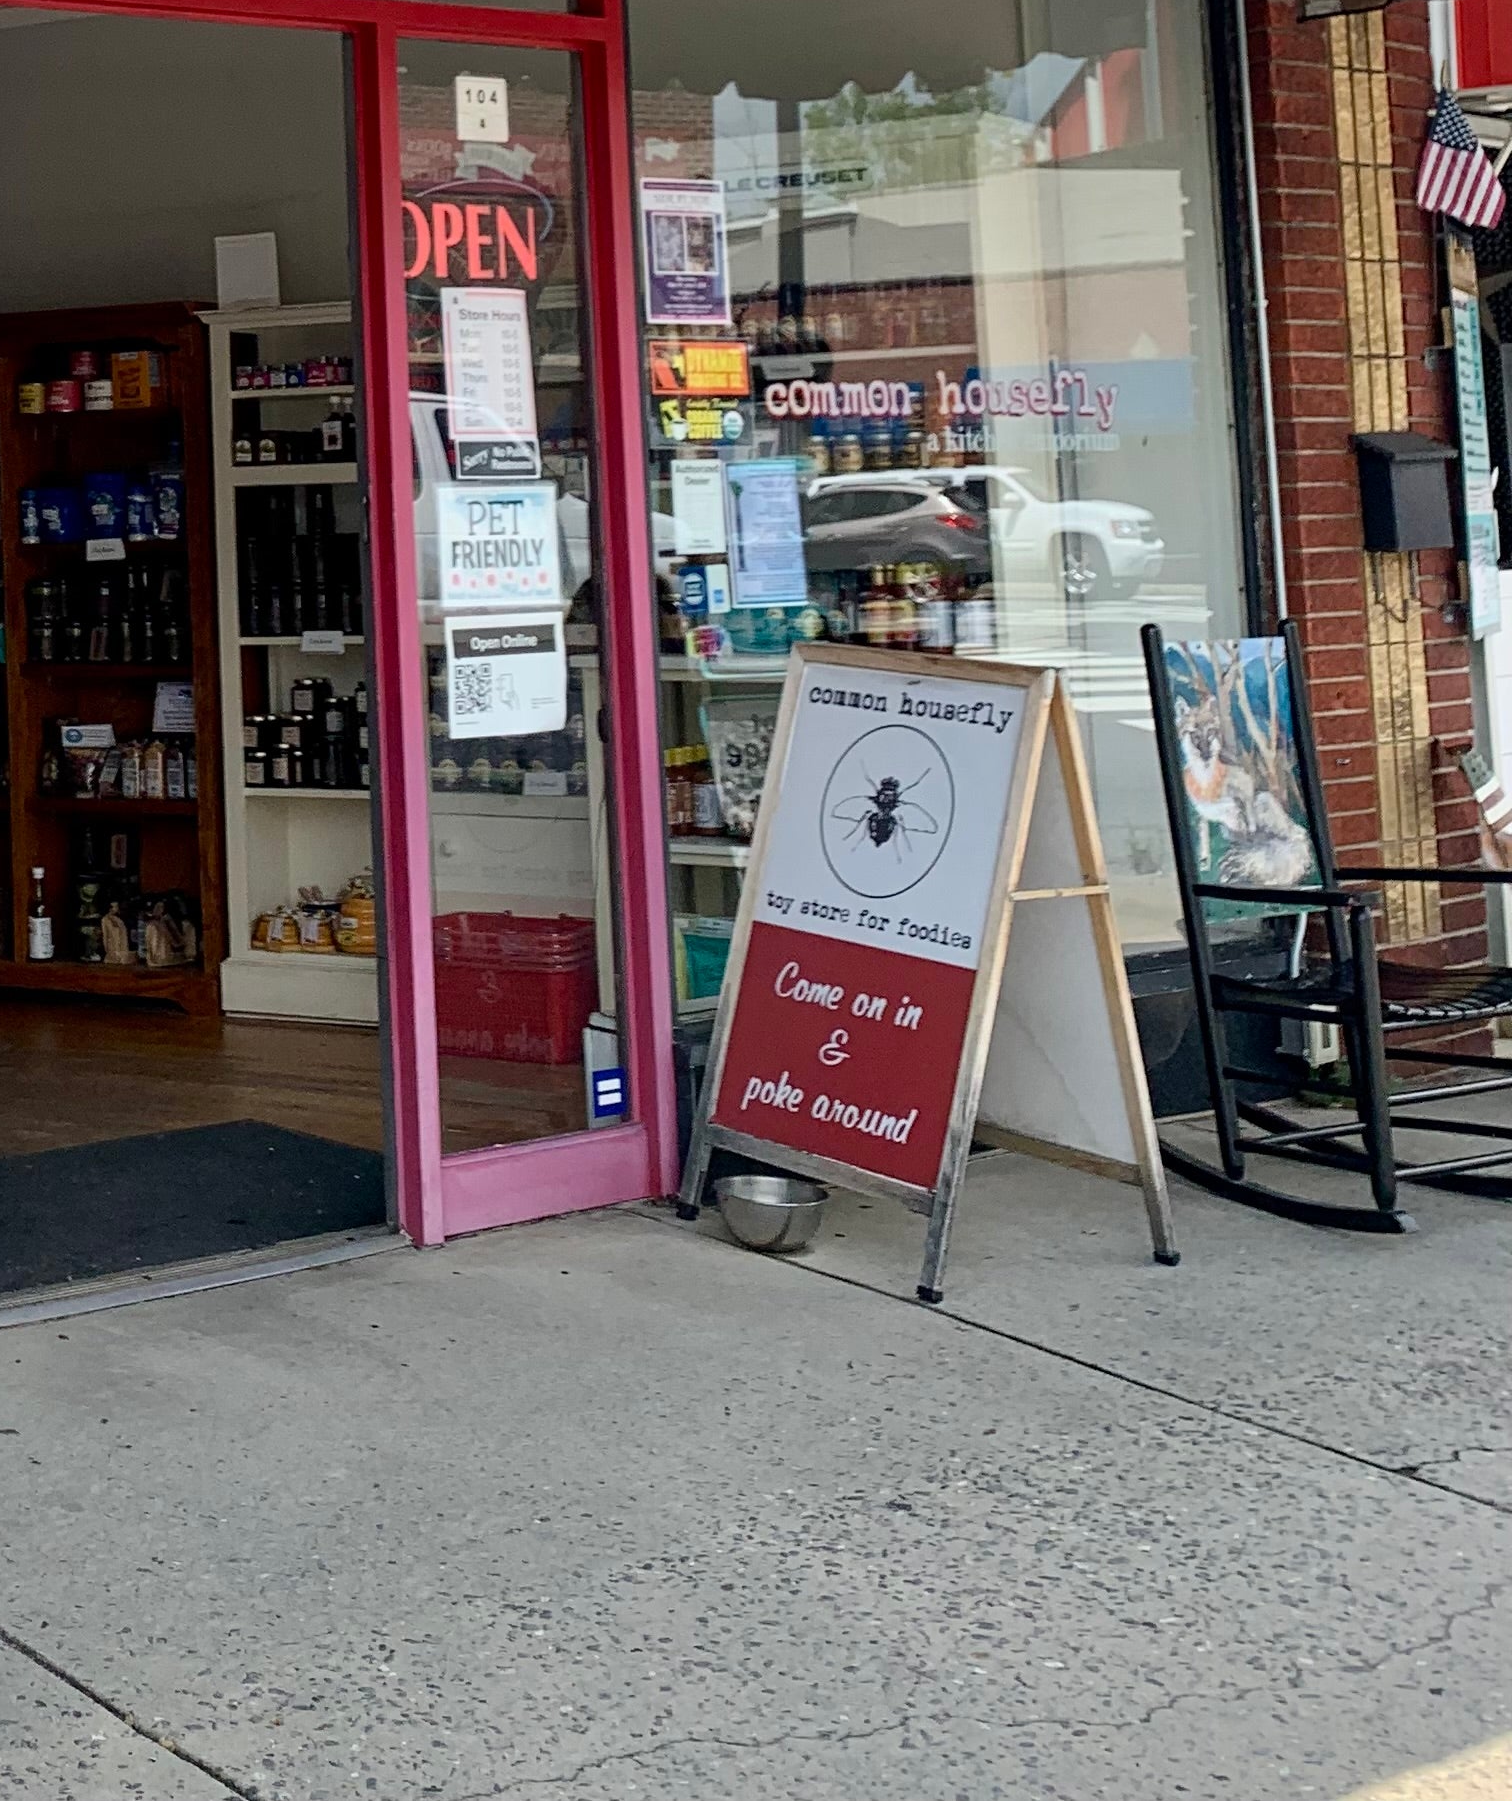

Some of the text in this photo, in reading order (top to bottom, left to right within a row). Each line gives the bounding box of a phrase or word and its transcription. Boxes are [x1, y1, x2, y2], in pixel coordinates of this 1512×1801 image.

[465, 88, 499, 105] 104
[724, 180, 753, 193] LE
[756, 167, 869, 190] CREUSET
[402, 201, 538, 281] OPEN
[458, 309, 521, 322] Store Hours
[765, 369, 1118, 431] common housefly
[467, 500, 524, 536] PET
[452, 538, 544, 569] FRIENDLY
[470, 634, 538, 652] Open Online
[808, 684, 1014, 733] common housefly
[766, 890, 972, 950] toy store for foodies
[774, 961, 924, 1030] Come on in
[818, 1028, 850, 1066] &
[741, 1070, 919, 1145] poke around
